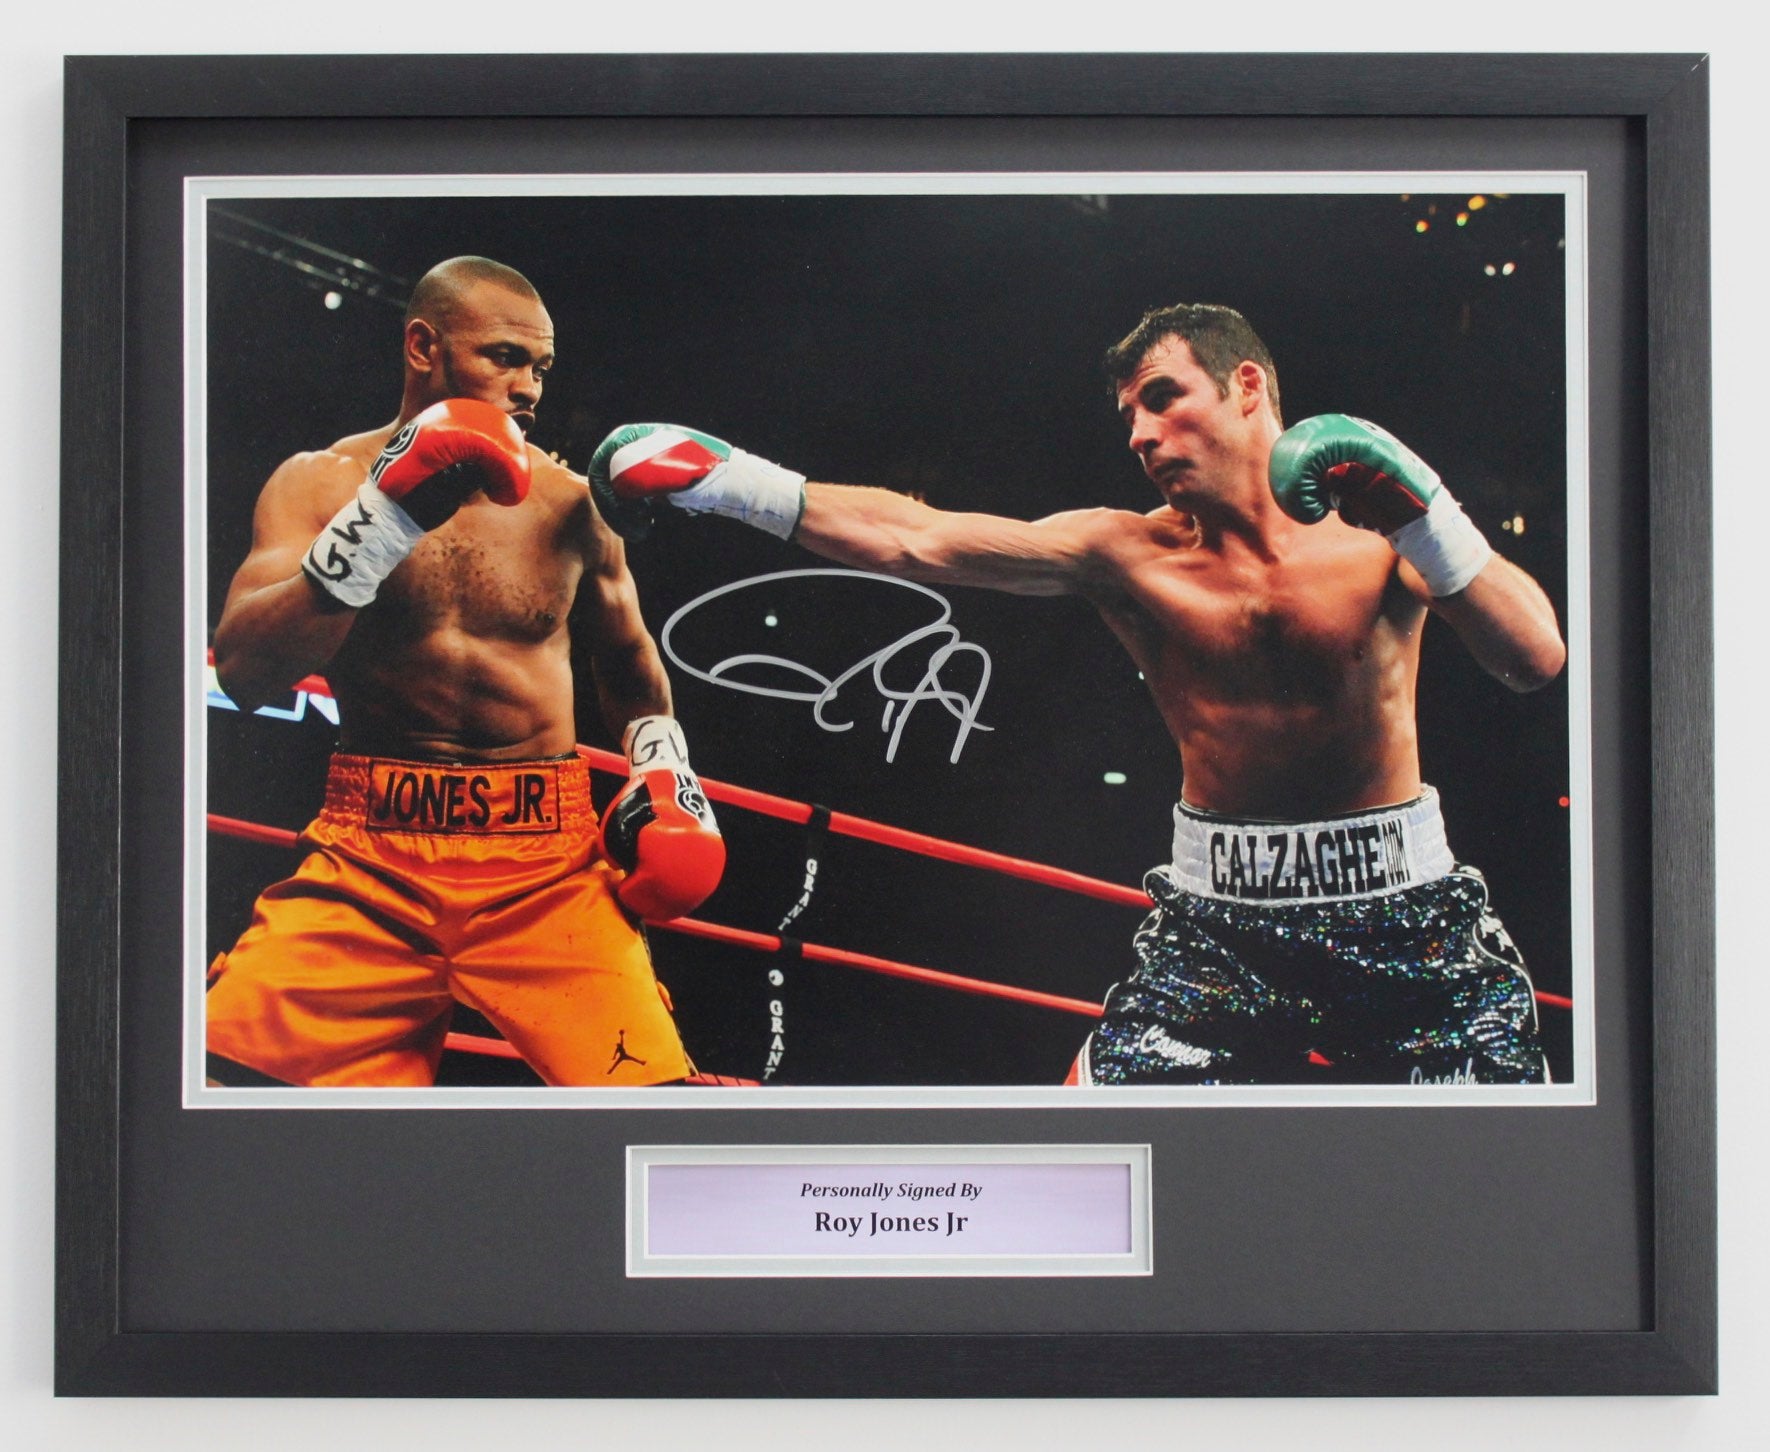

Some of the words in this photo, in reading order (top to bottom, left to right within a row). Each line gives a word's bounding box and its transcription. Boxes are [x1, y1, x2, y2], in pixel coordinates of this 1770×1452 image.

[374, 771, 491, 827] JONES
[502, 773, 552, 825] JR.
[777, 858, 818, 931] GRANT
[763, 1000, 785, 1080] GRANT
[800, 1182, 893, 1201] Personally
[897, 1182, 957, 1201] Signed
[960, 1182, 983, 1201] By
[815, 1211, 863, 1237] Roy
[870, 1211, 939, 1237] Jones
[946, 1211, 969, 1237] Jr
